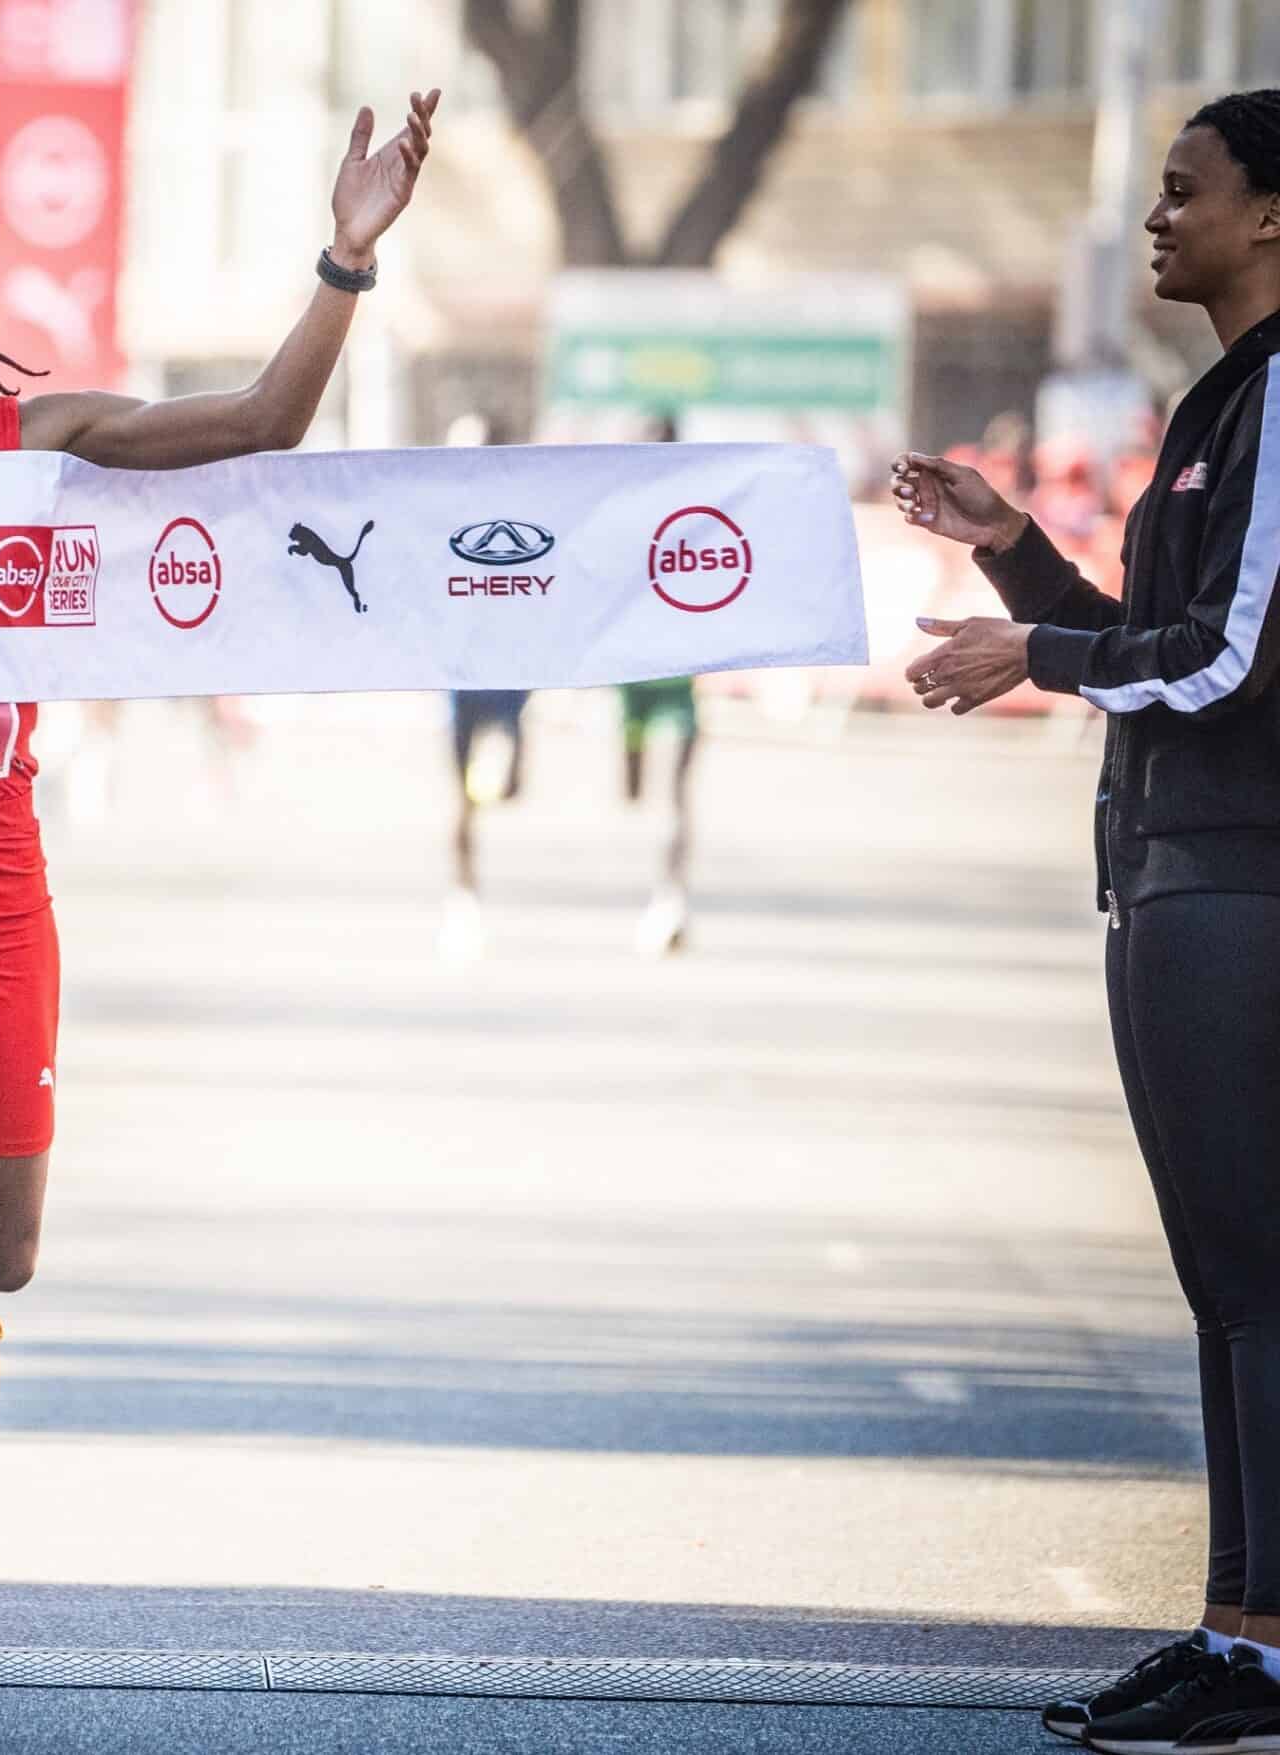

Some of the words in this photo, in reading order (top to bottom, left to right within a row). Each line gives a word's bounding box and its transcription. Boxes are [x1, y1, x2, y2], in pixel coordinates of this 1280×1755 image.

[54, 539, 96, 572] RUN
[157, 551, 212, 585] absa
[660, 539, 739, 574] absa
[50, 575, 71, 588] OUR
[448, 575, 555, 597] CHERY
